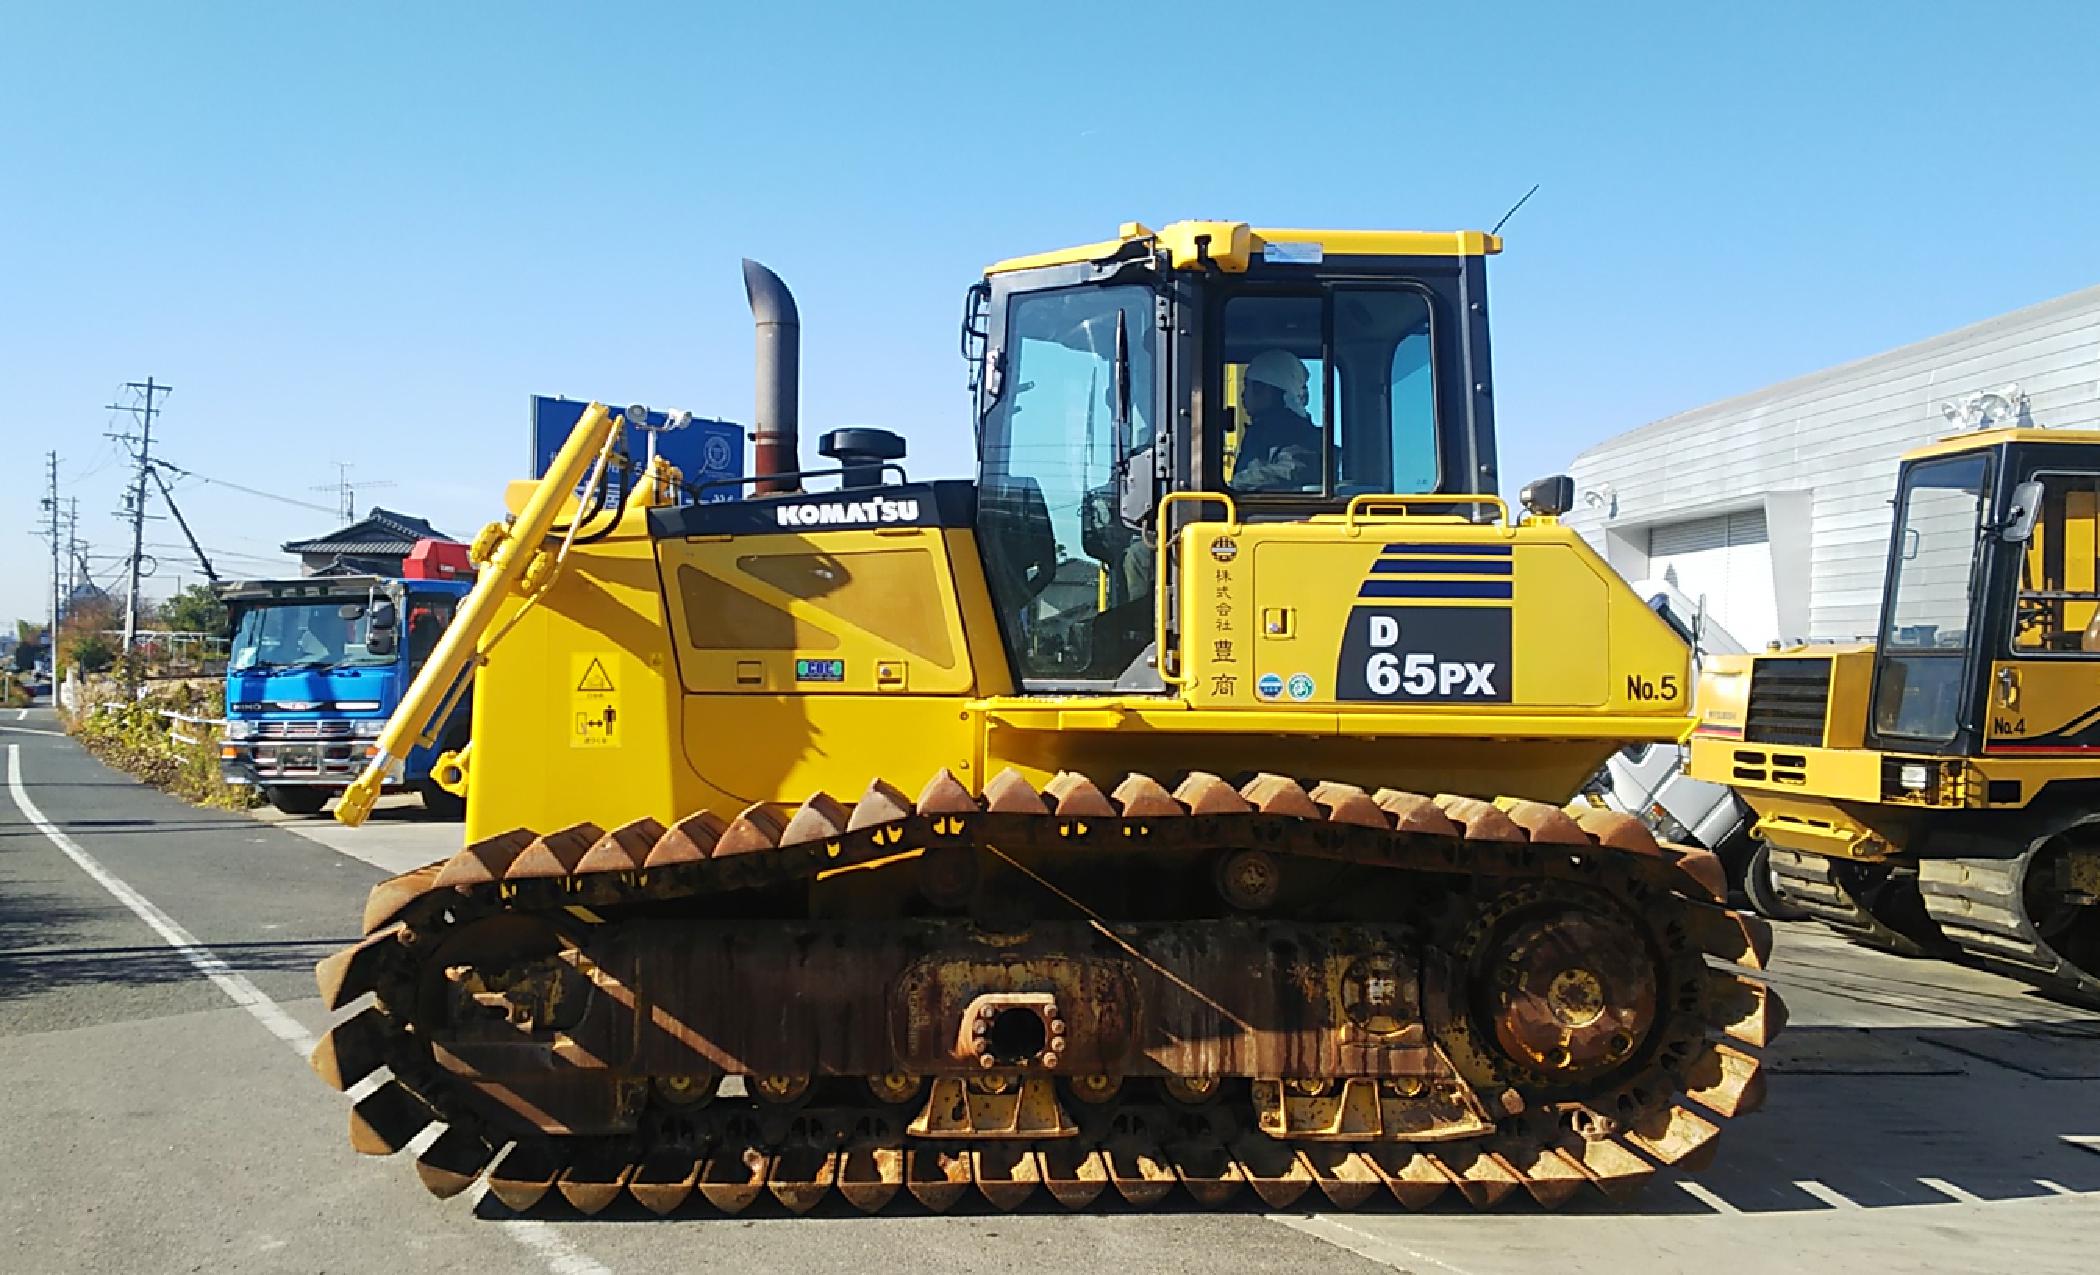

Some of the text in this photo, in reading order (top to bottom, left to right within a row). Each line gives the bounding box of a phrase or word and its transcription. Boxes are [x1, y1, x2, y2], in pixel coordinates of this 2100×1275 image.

[777, 496, 919, 526] KOMATSU
[1370, 616, 1398, 647] D
[1366, 653, 1497, 695] 65PX
[1627, 674, 1678, 700] No.5
